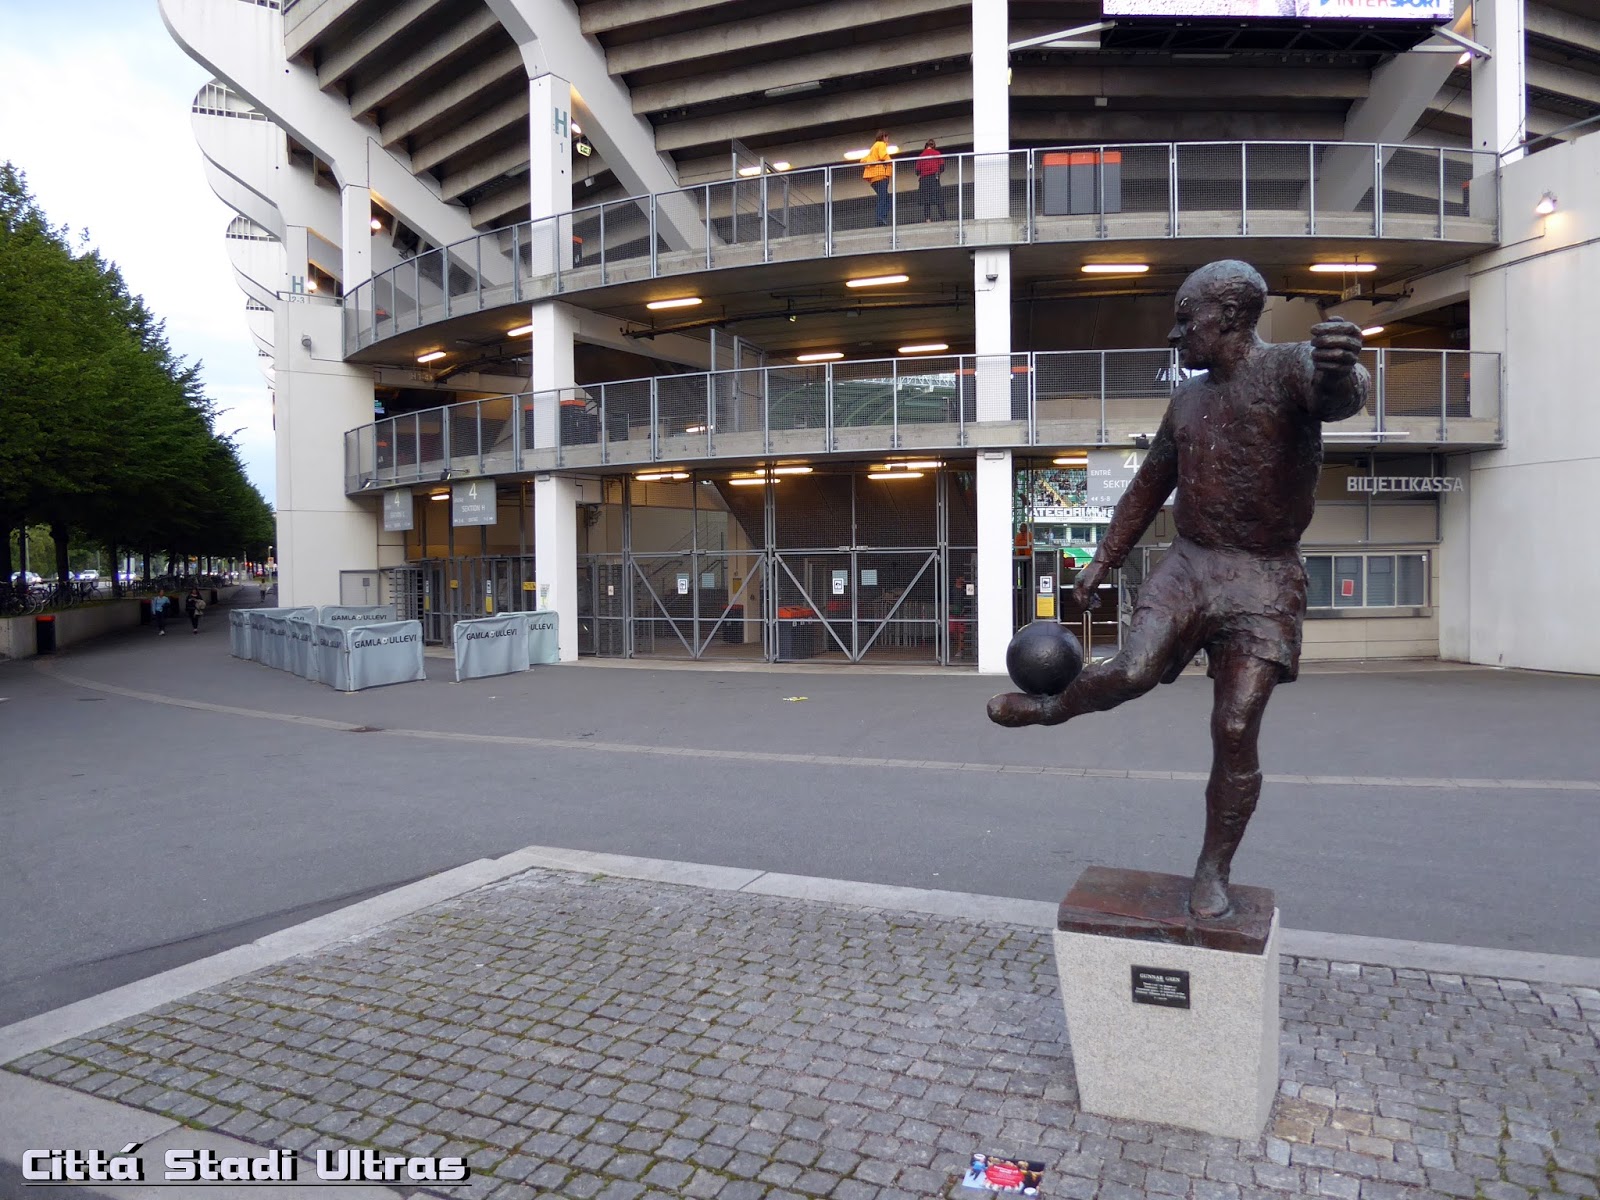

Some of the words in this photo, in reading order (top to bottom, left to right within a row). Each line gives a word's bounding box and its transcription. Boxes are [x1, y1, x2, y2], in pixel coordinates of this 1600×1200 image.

[555, 107, 568, 139] H
[292, 275, 304, 294] H
[1123, 451, 1141, 474] 4
[1090, 469, 1111, 477] ENTRÉ
[468, 482, 478, 500] 4
[1103, 480, 1131, 489] SEKTI
[1346, 476, 1465, 495] BILJETTKASSA
[466, 631, 490, 641] GAMLA
[495, 628, 518, 638] ULLEVI
[530, 623, 554, 631] ULLEVI
[354, 639, 382, 649] GAMLA
[389, 634, 417, 644] ULLEVI
[1139, 972, 1164, 981] GUNNAR
